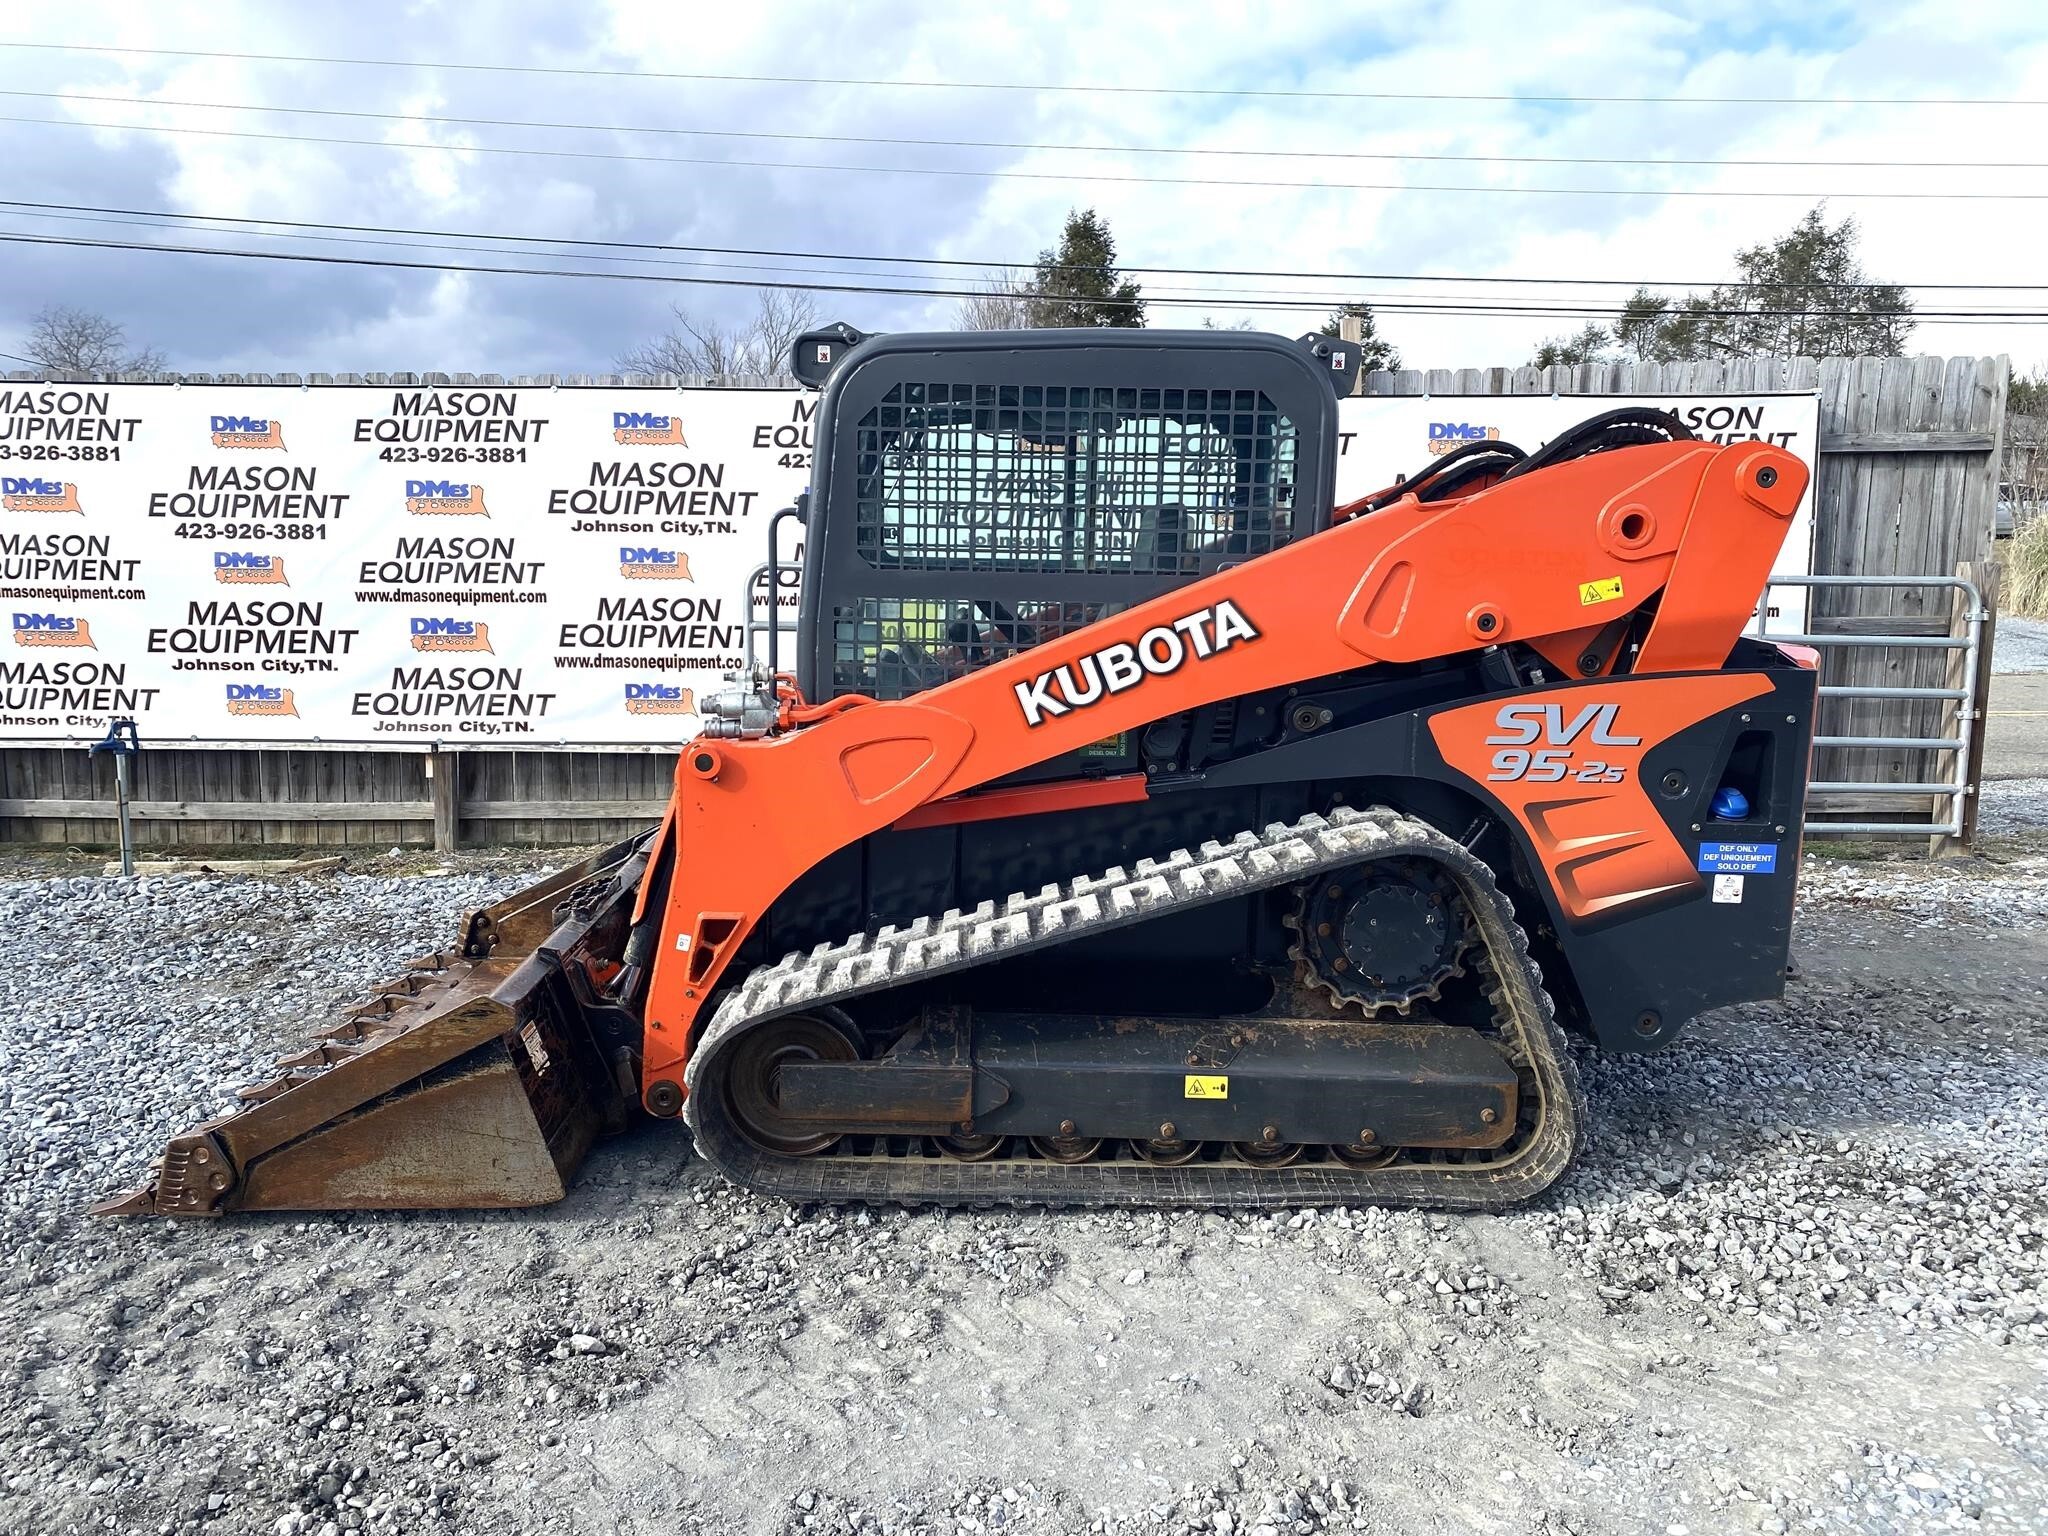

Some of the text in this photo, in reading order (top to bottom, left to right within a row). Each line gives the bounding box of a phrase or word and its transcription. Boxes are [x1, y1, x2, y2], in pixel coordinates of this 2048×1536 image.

[392, 392, 517, 417] MASON
[353, 418, 550, 443] EQUIPMENT
[379, 447, 527, 463] 423-926-3881
[188, 465, 317, 492] MASON
[589, 461, 725, 488] MASON
[148, 492, 350, 519] EQUIPMENT
[547, 489, 759, 516] EQUIPMENT
[174, 522, 326, 540] 423-926-3881
[570, 519, 654, 533] Johnson
[0, 533, 110, 557] MASON
[395, 537, 515, 560] MASON
[0, 558, 141, 582] UIPMENT
[359, 561, 546, 584] EQUIPMENT
[0, 586, 146, 603] masonequipment.com
[354, 588, 547, 605] www.dmasonequipment.com
[187, 601, 323, 627] MASON
[597, 597, 722, 622] MASON
[147, 628, 360, 654] EQUIPMENT
[0, 661, 126, 686] MASON
[171, 658, 255, 671] Johnson
[553, 653, 744, 672] www.dmasonequipment.co
[1014, 600, 1259, 726] KUBOTA
[391, 667, 522, 691] MASON
[0, 687, 161, 711] UIPMENT
[351, 692, 557, 717] EQUIPMENT
[373, 720, 452, 732] Johnson
[1485, 703, 1642, 746] SVL
[1704, 853, 1719, 861] DEF
